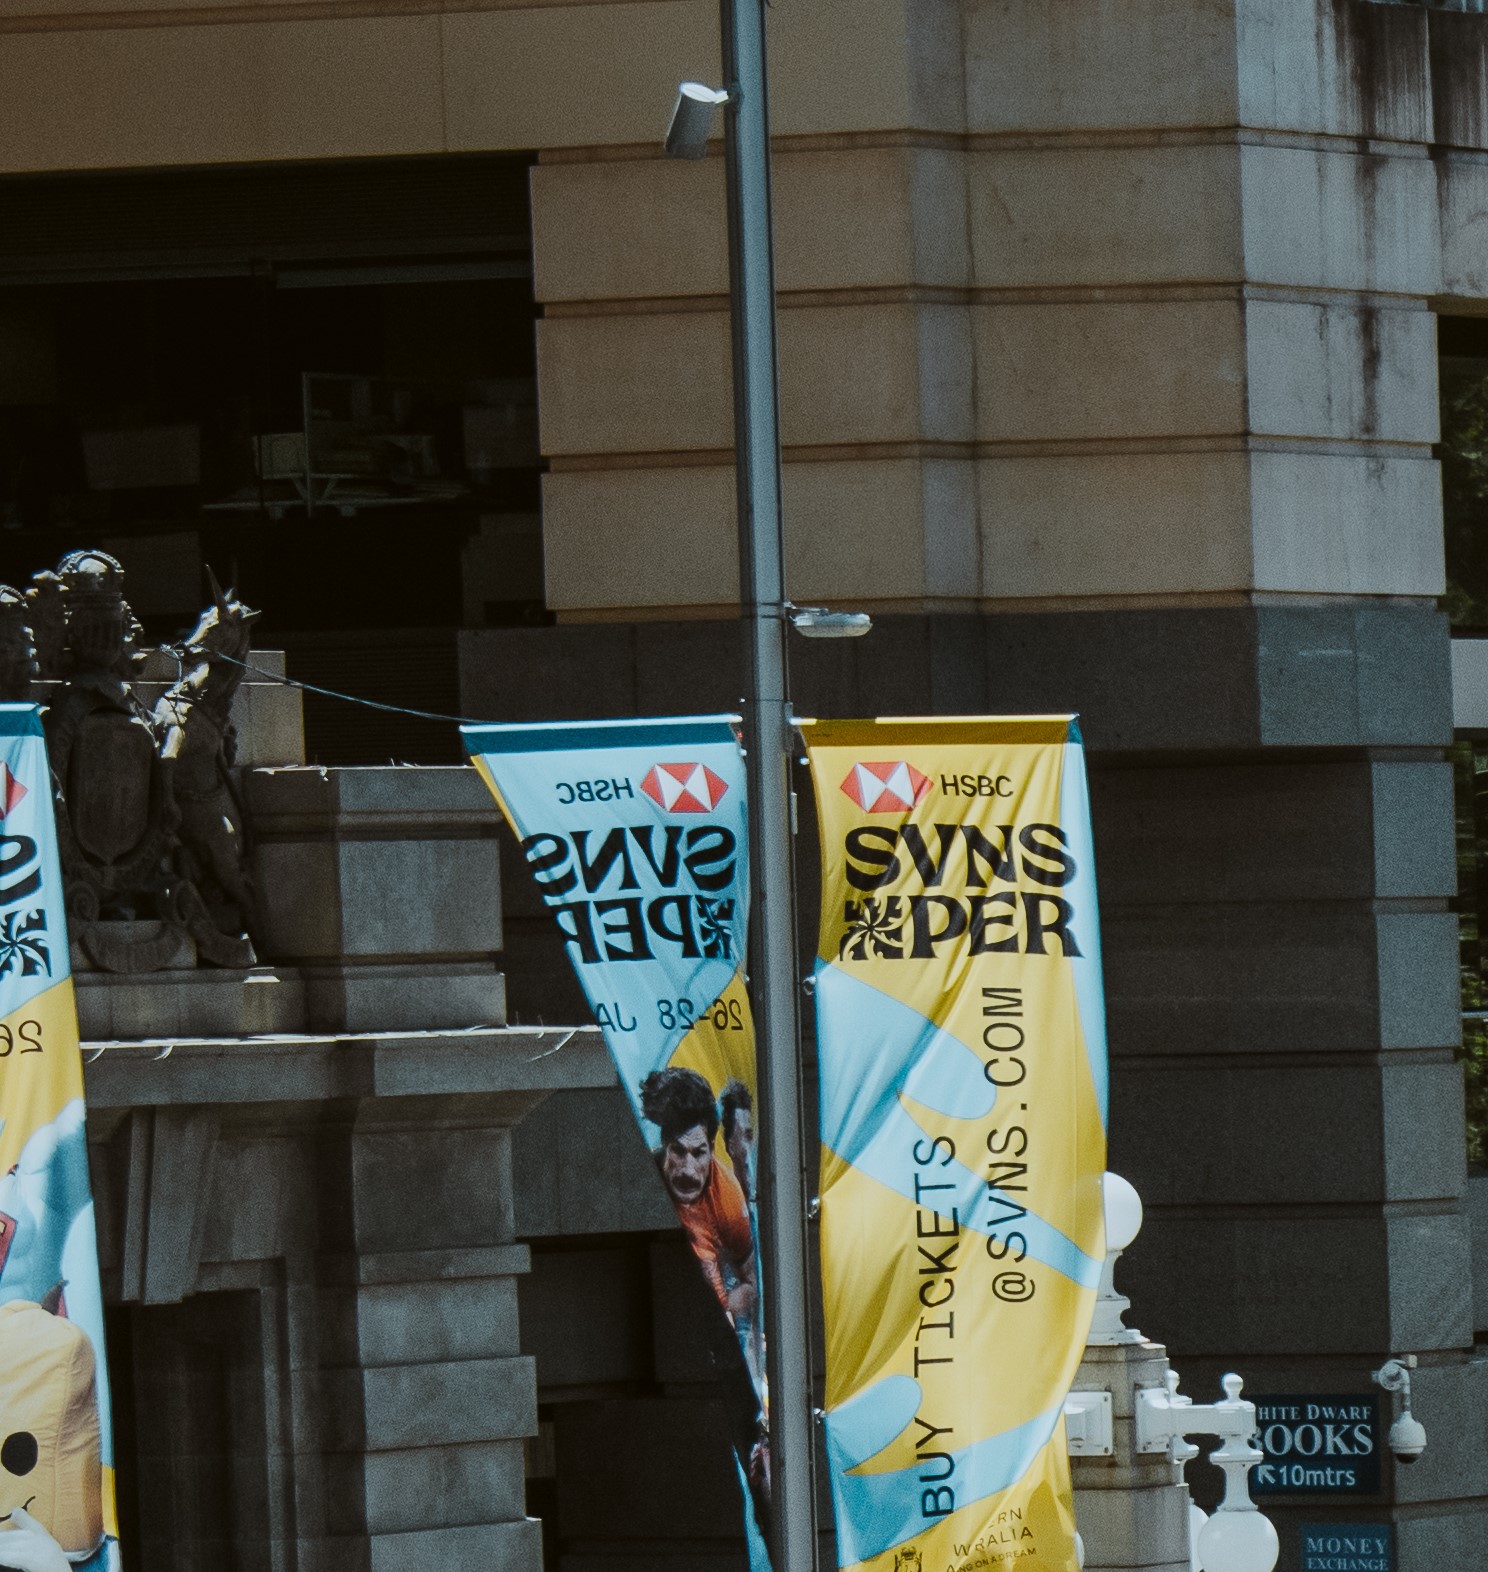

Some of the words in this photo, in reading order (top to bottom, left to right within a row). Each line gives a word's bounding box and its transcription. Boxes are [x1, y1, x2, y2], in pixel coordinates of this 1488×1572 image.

[940, 773, 1014, 798] HSBC
[845, 822, 1077, 892] SVNS
[908, 890, 1086, 960] PER
[913, 1135, 960, 1378] TICKETS
[1258, 1405, 1300, 1421] HITE
[1307, 1404, 1372, 1421] DWARF
[913, 1416, 955, 1519] BUY
[1279, 1464, 1356, 1486] 10mtrs
[1307, 1537, 1388, 1555] MONEY
[1307, 1558, 1389, 1572] EXCHANGE
